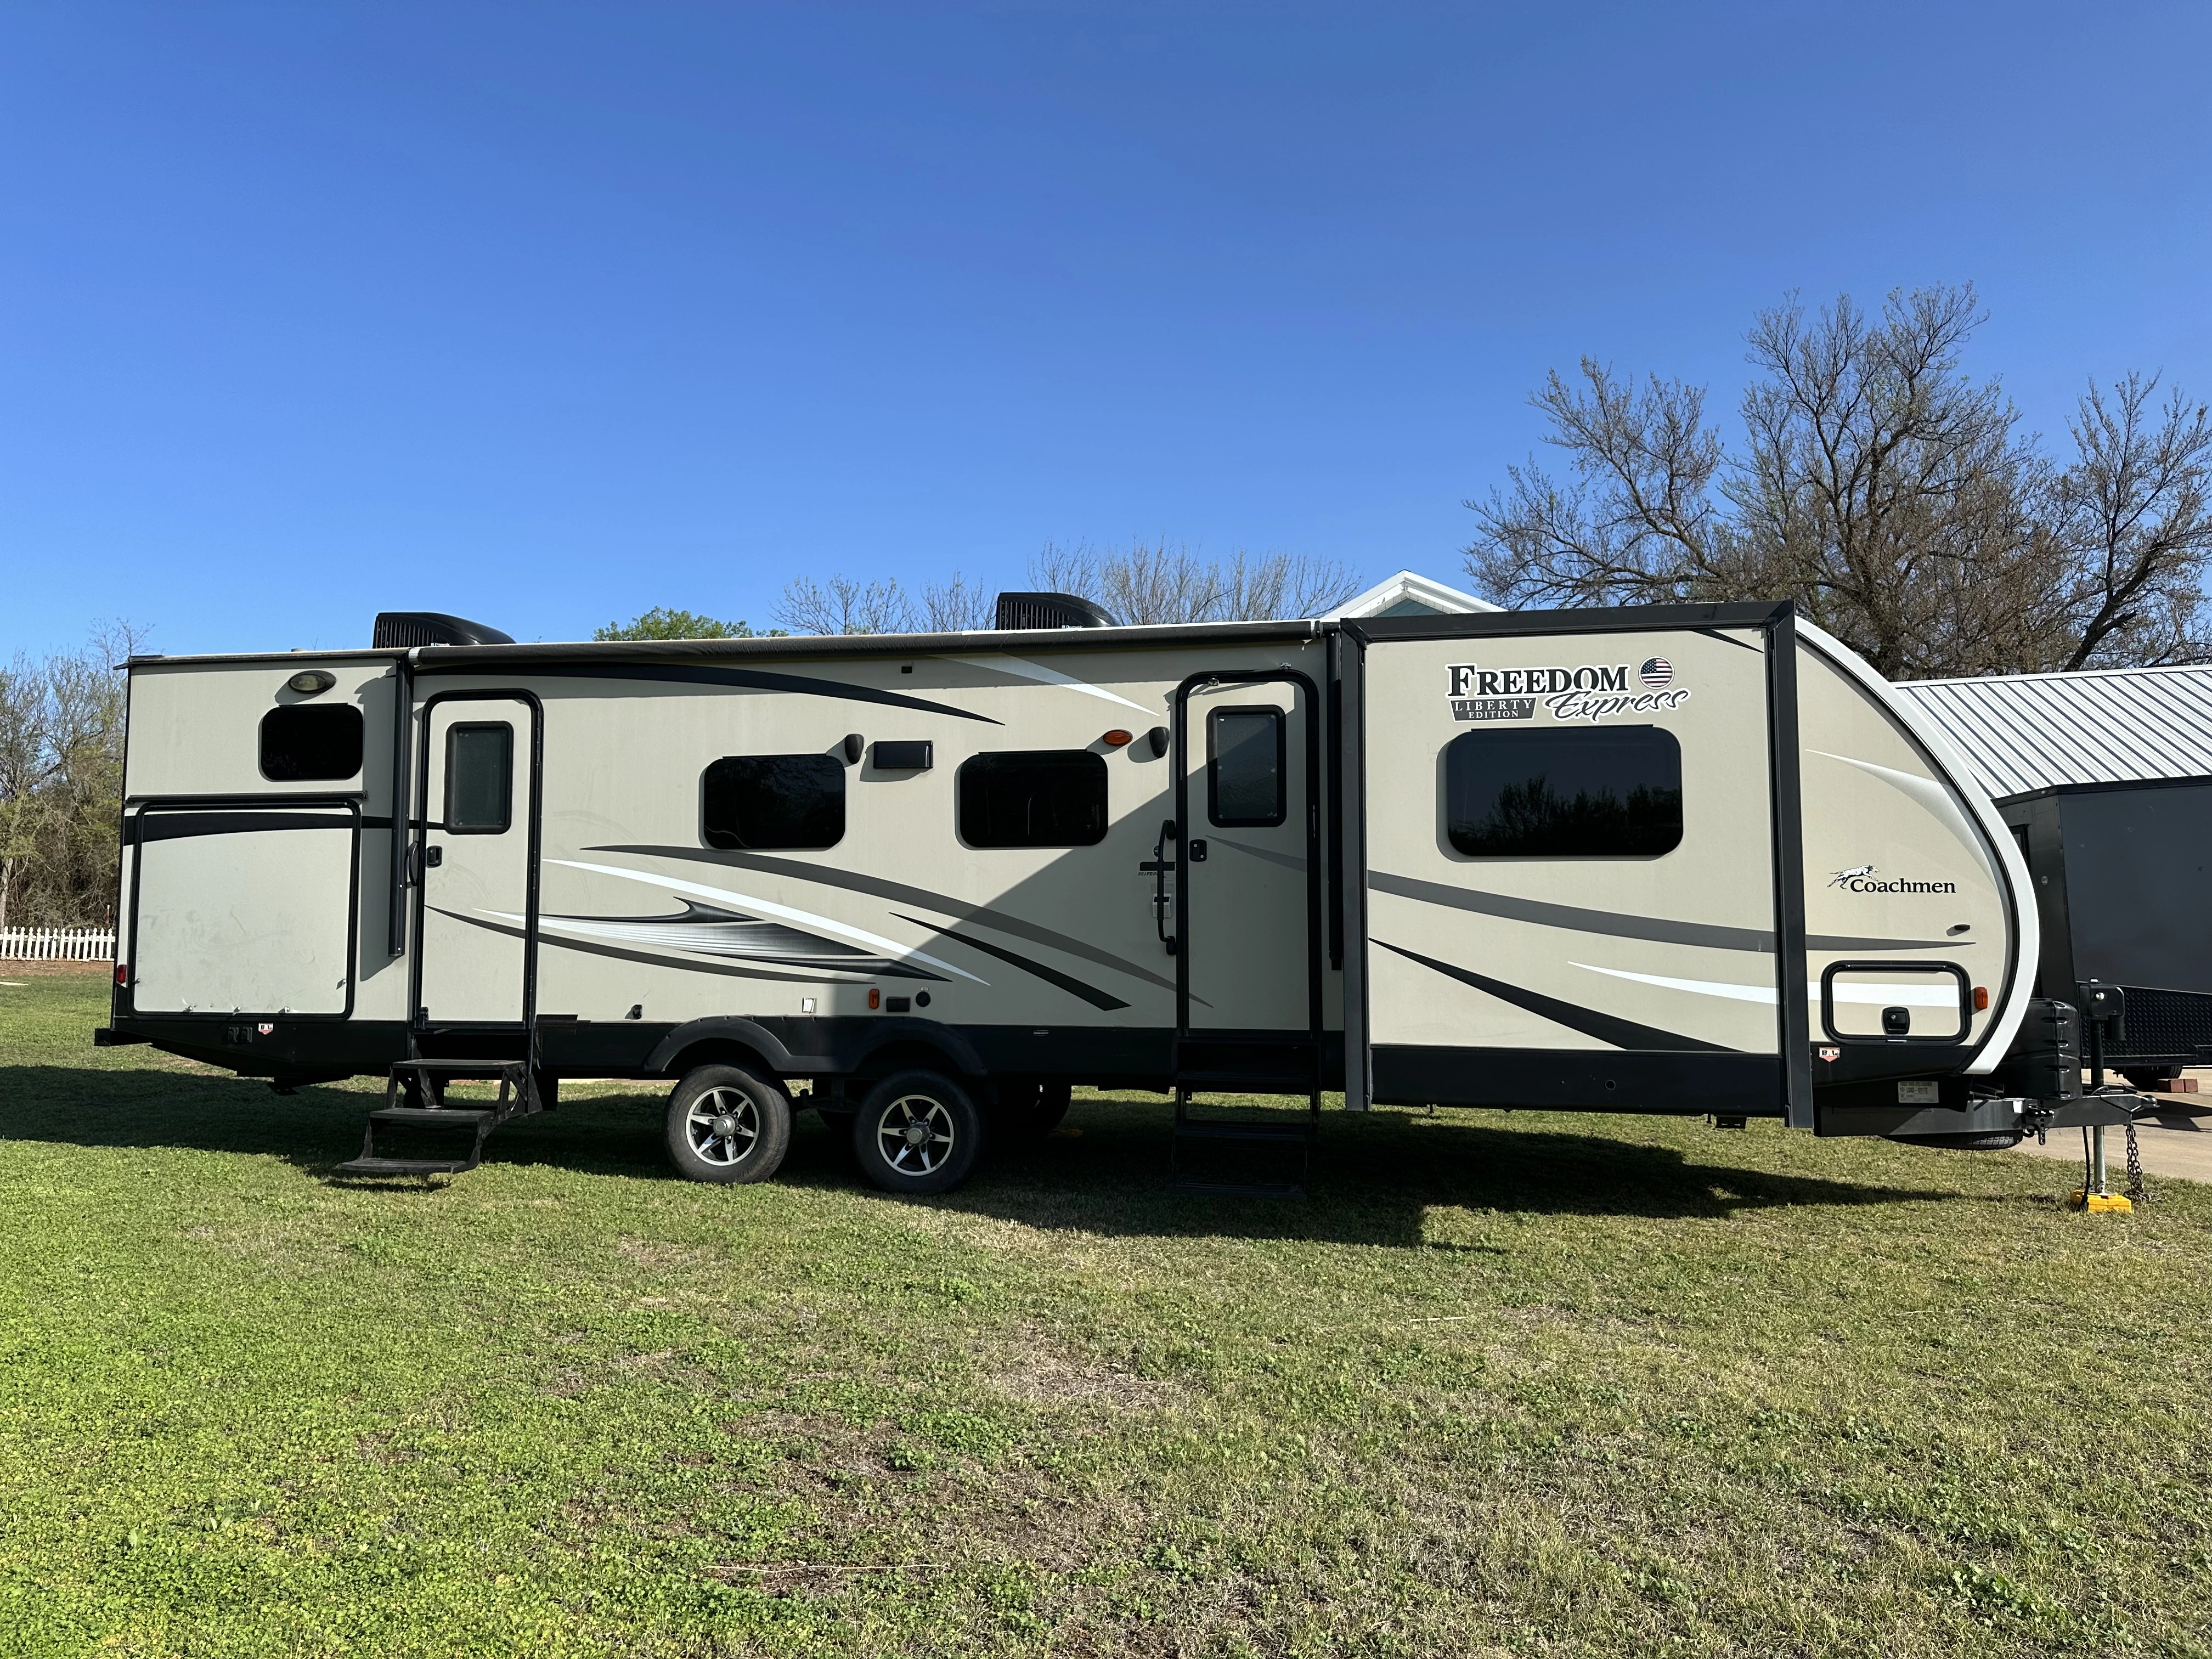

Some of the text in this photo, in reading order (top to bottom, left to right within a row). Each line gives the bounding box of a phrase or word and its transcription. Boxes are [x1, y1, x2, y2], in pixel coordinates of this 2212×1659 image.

[1447, 665, 1628, 697] FREEDOM
[1455, 699, 1532, 712] LIBERTY
[1545, 690, 1689, 721] Express
[1468, 710, 1519, 719] EDITION
[1850, 878, 1956, 894] Coachmen
